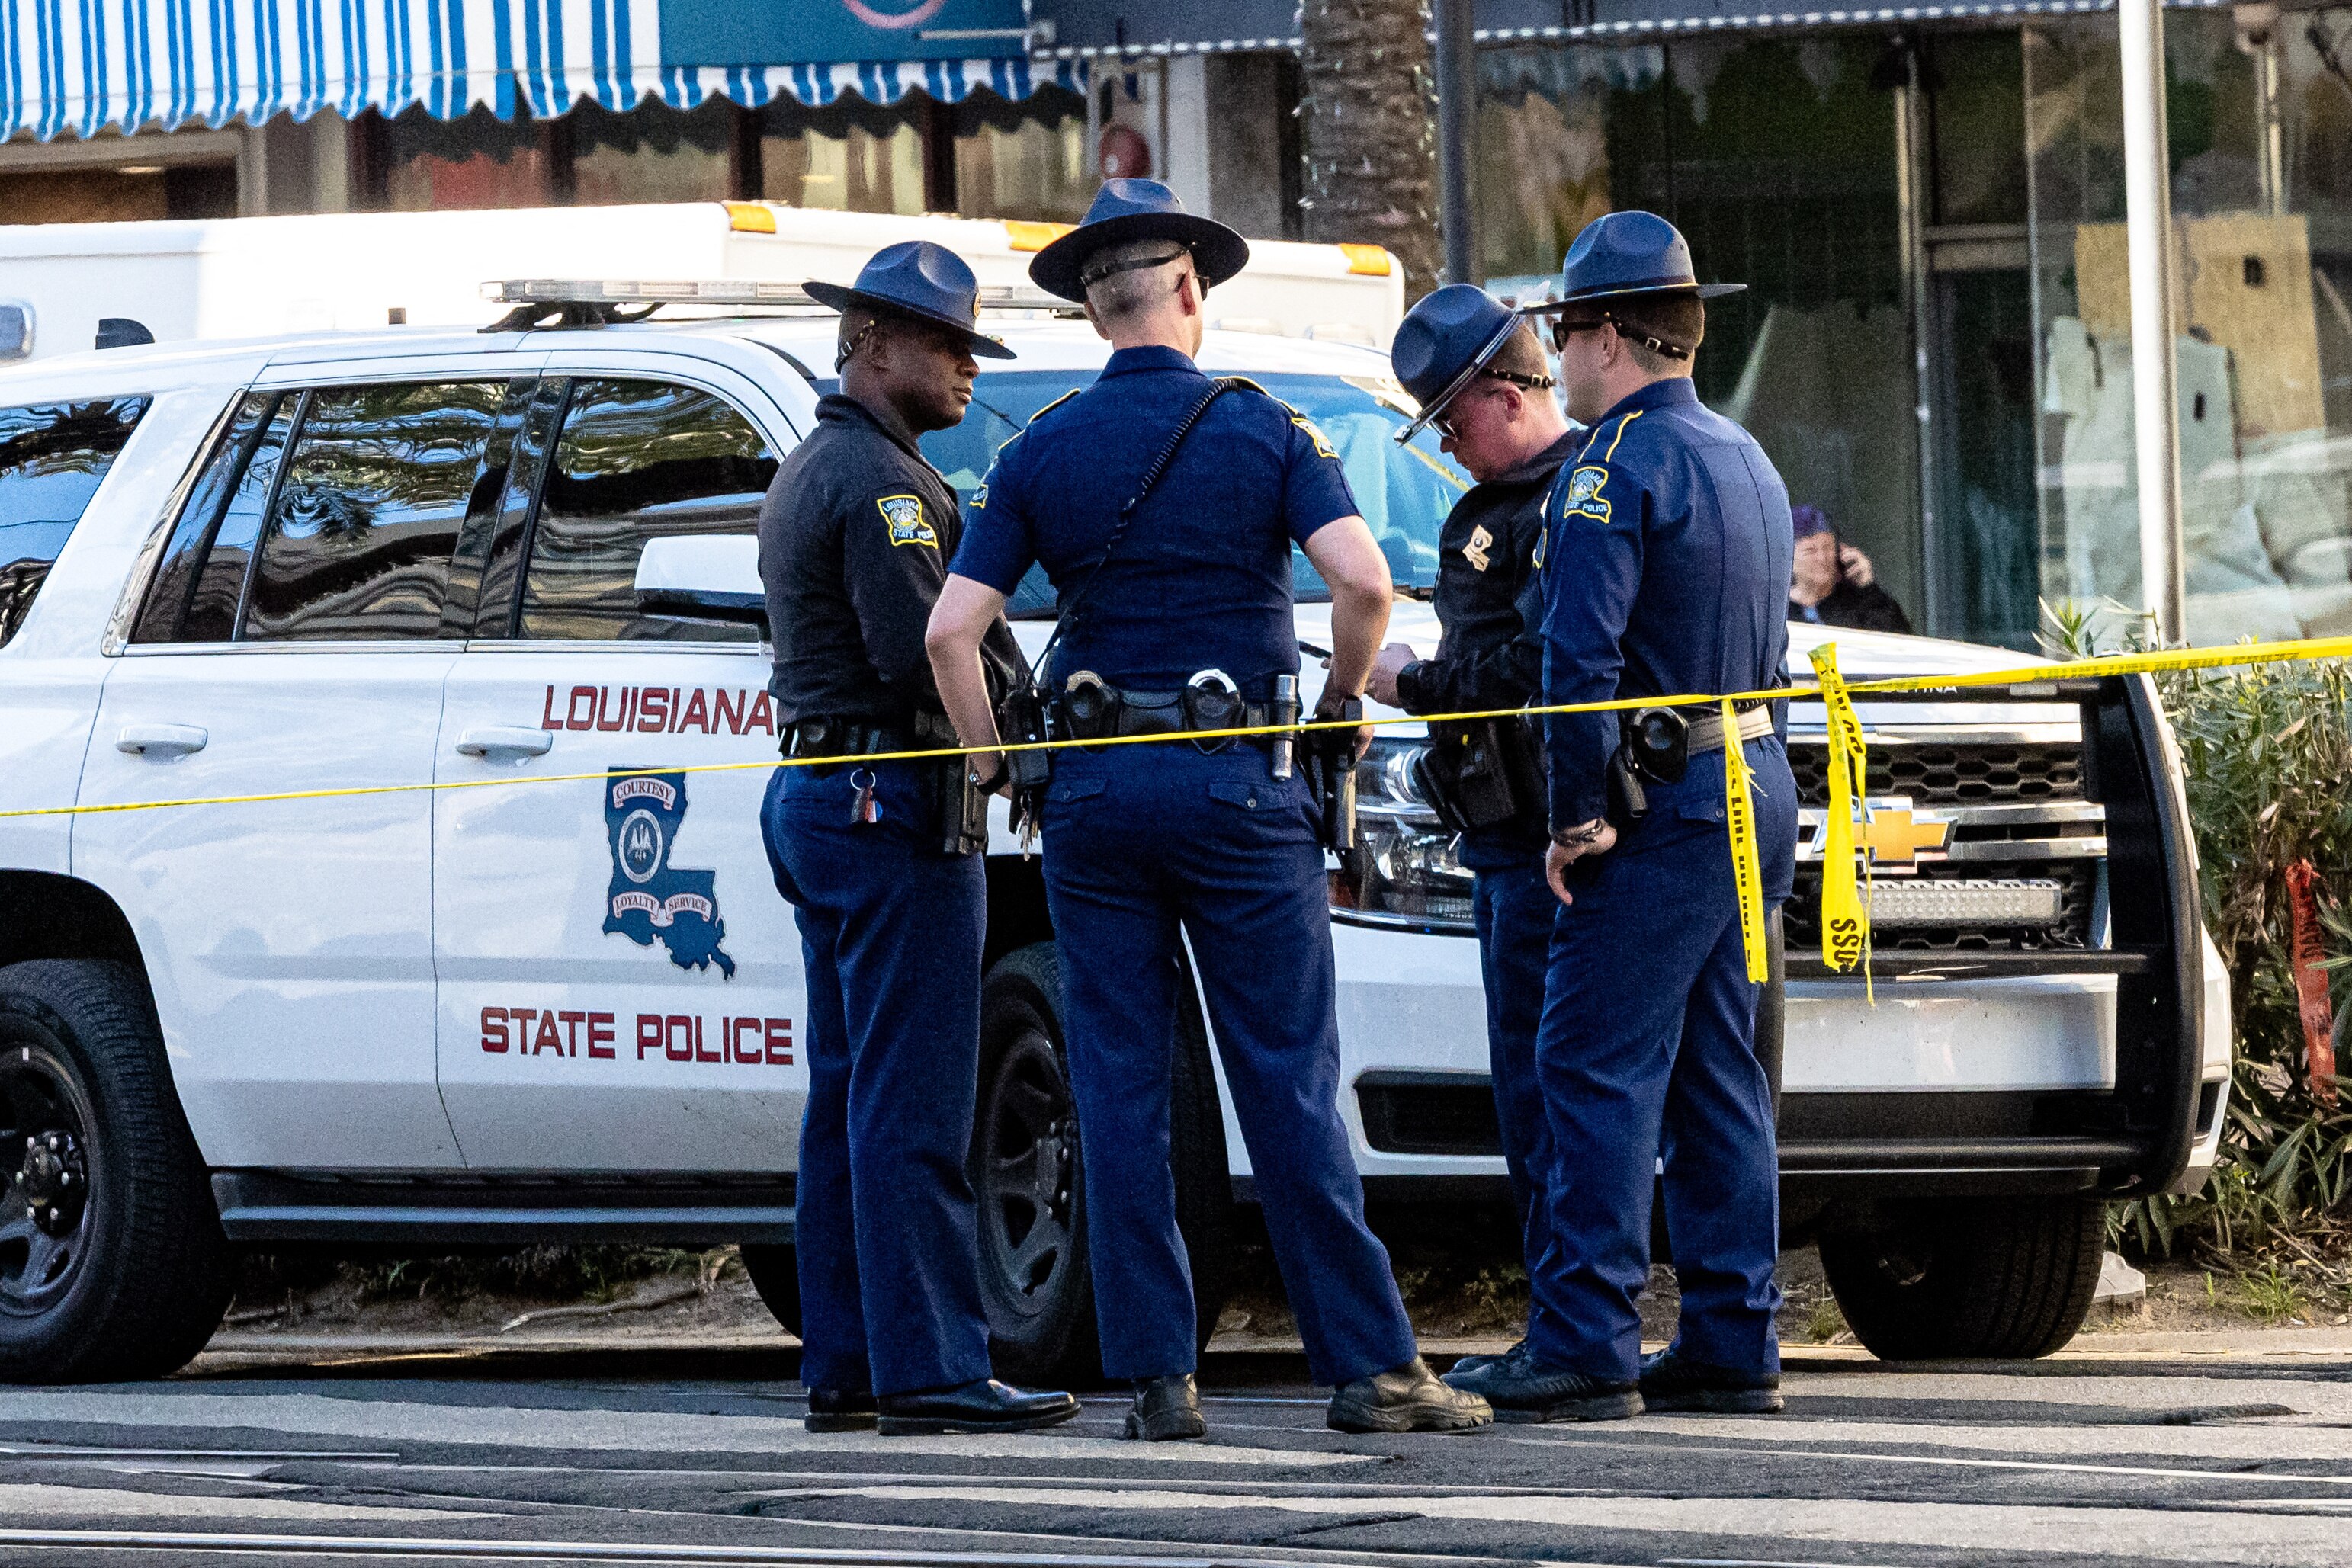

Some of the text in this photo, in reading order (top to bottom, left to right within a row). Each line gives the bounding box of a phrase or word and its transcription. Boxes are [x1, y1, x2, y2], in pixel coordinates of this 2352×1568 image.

[882, 499, 919, 512] LOUISIANA
[1582, 503, 1608, 513] POLICE
[893, 528, 914, 539] STATE
[541, 685, 775, 736] LOUISIANA
[615, 780, 672, 801] COURTESY
[615, 895, 656, 913] LOYALTY
[668, 897, 708, 911] SERVICE
[481, 1006, 794, 1066] STATE POLICE
